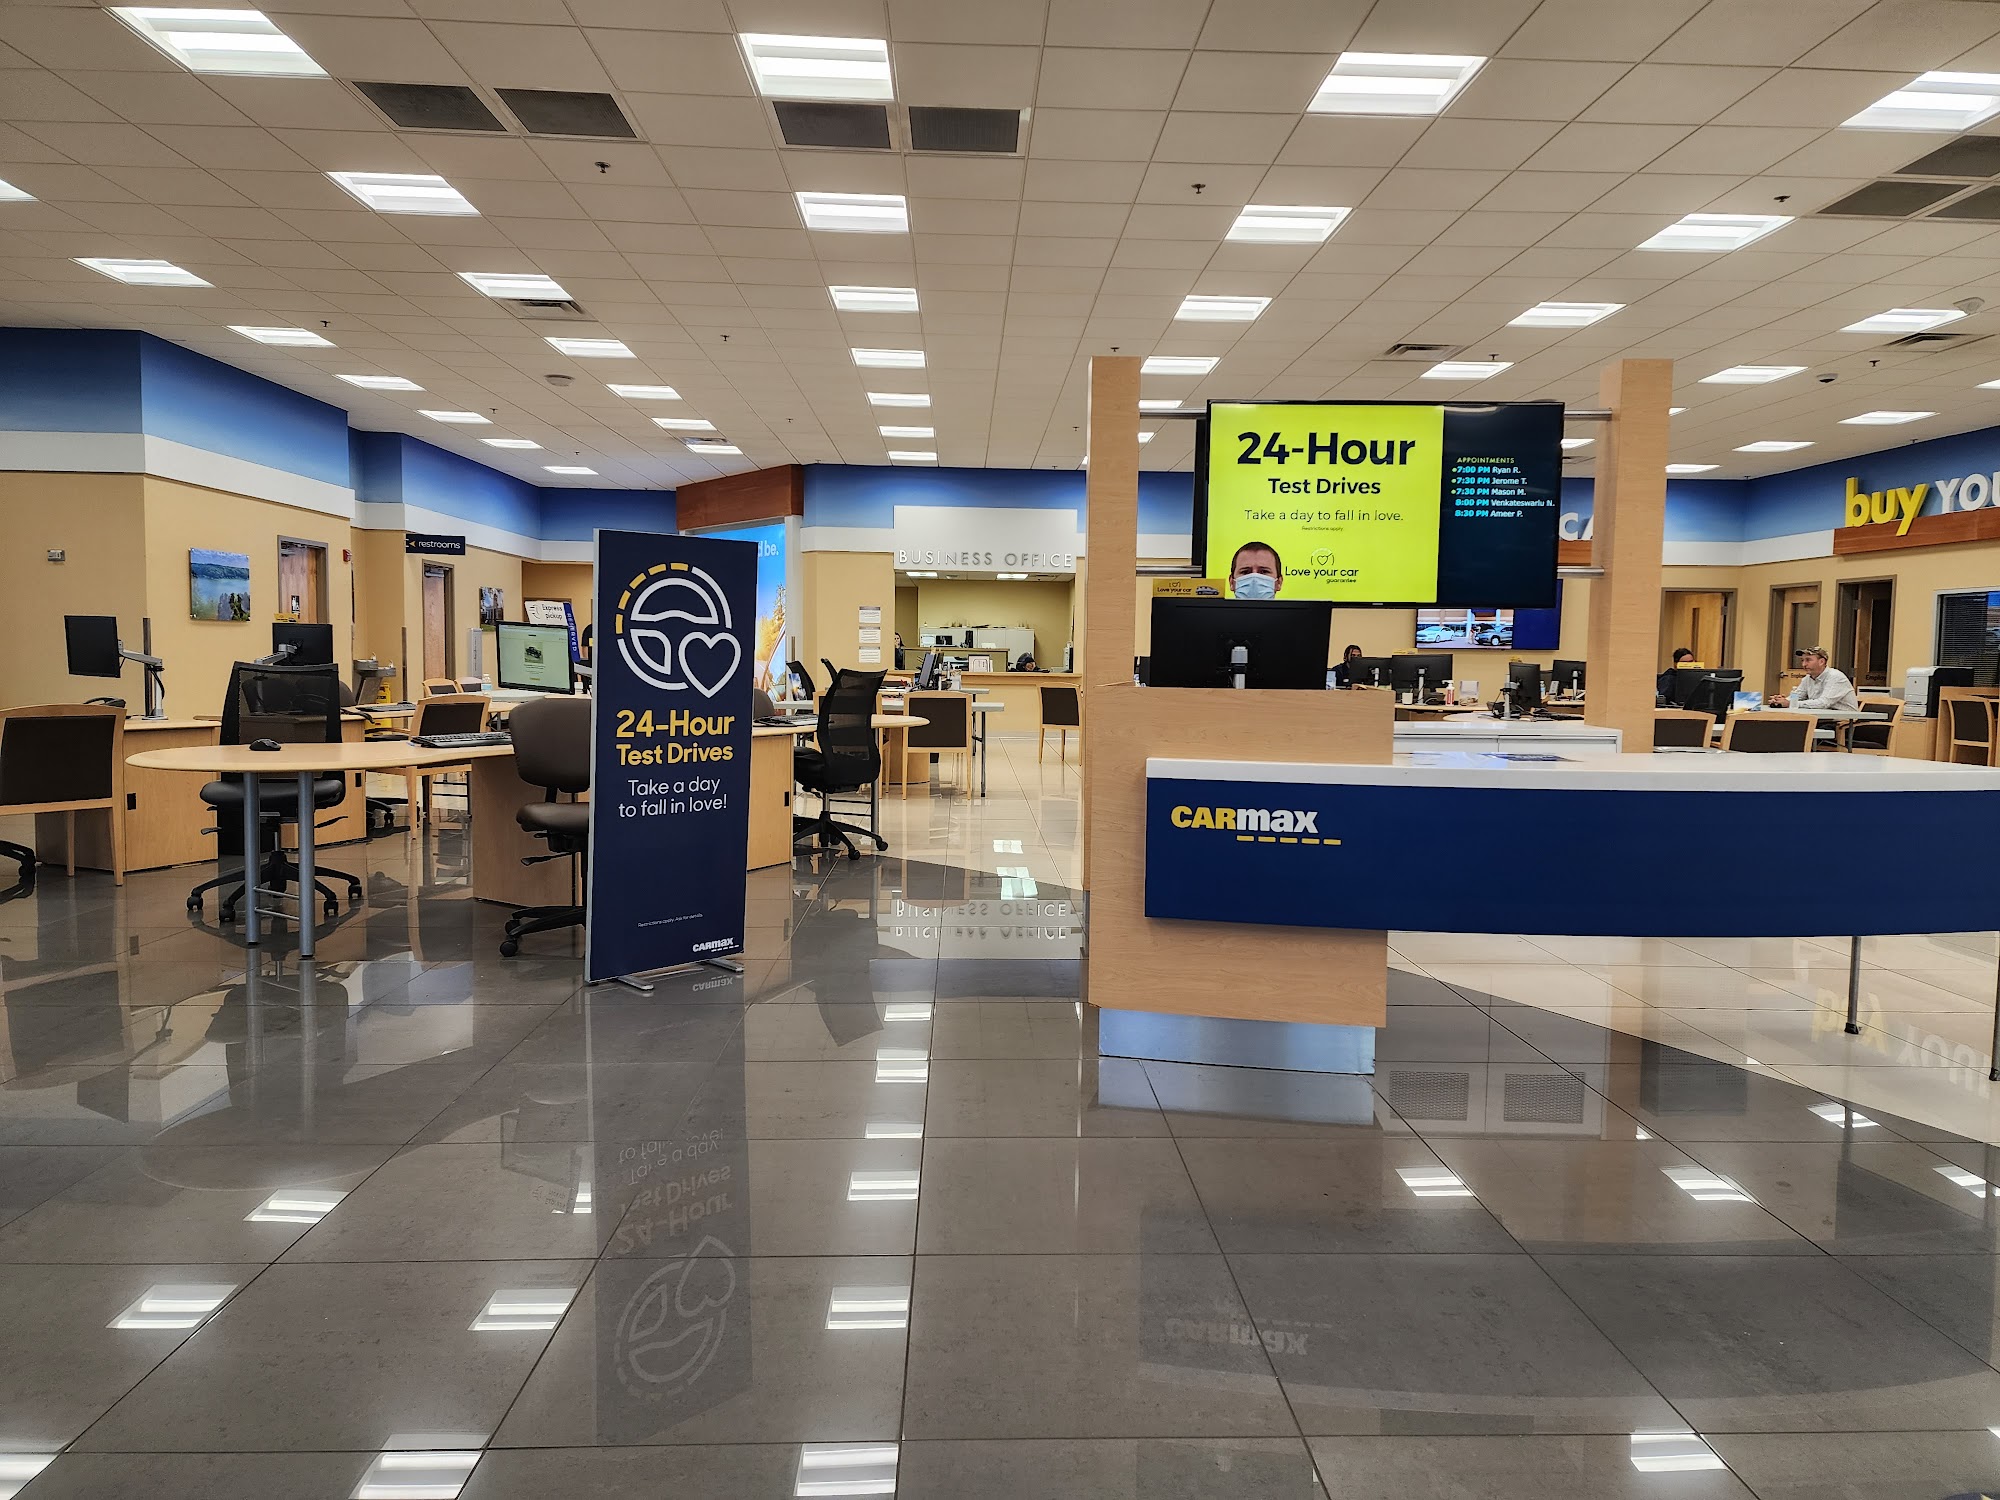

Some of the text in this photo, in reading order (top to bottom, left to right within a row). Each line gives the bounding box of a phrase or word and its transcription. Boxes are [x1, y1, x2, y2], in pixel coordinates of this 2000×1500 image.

[1237, 432, 1416, 465] 24-Hour
[1492, 467, 1511, 475] Ryan
[1268, 477, 1381, 494] Test Drives
[1845, 476, 1930, 536] buy
[1244, 509, 1404, 523] Take a day to fall in love.
[418, 540, 461, 549] restrooms
[764, 540, 779, 557] be.
[898, 550, 1072, 568] BUSINESS OFFICE
[1285, 566, 1311, 576] Love
[1313, 569, 1338, 579] your
[541, 604, 563, 612] Express
[616, 709, 735, 738] 24-Hour
[615, 742, 734, 766] Test Drives
[627, 775, 721, 797] Take a day
[618, 793, 727, 818] to fall in love!
